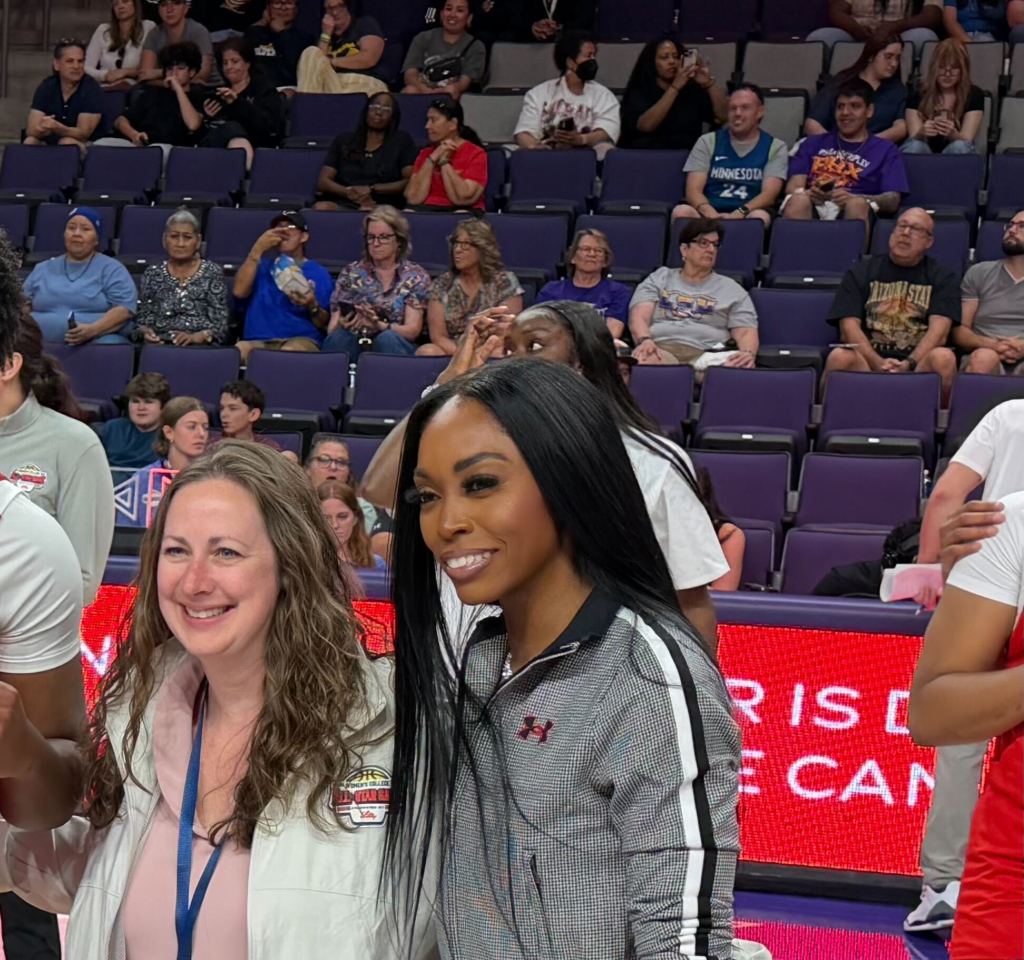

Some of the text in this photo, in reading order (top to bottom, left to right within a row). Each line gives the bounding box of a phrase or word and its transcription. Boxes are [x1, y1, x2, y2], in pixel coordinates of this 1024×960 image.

[710, 166, 763, 180] MINNESOTA
[719, 183, 748, 199] 24
[789, 683, 861, 731] IS
